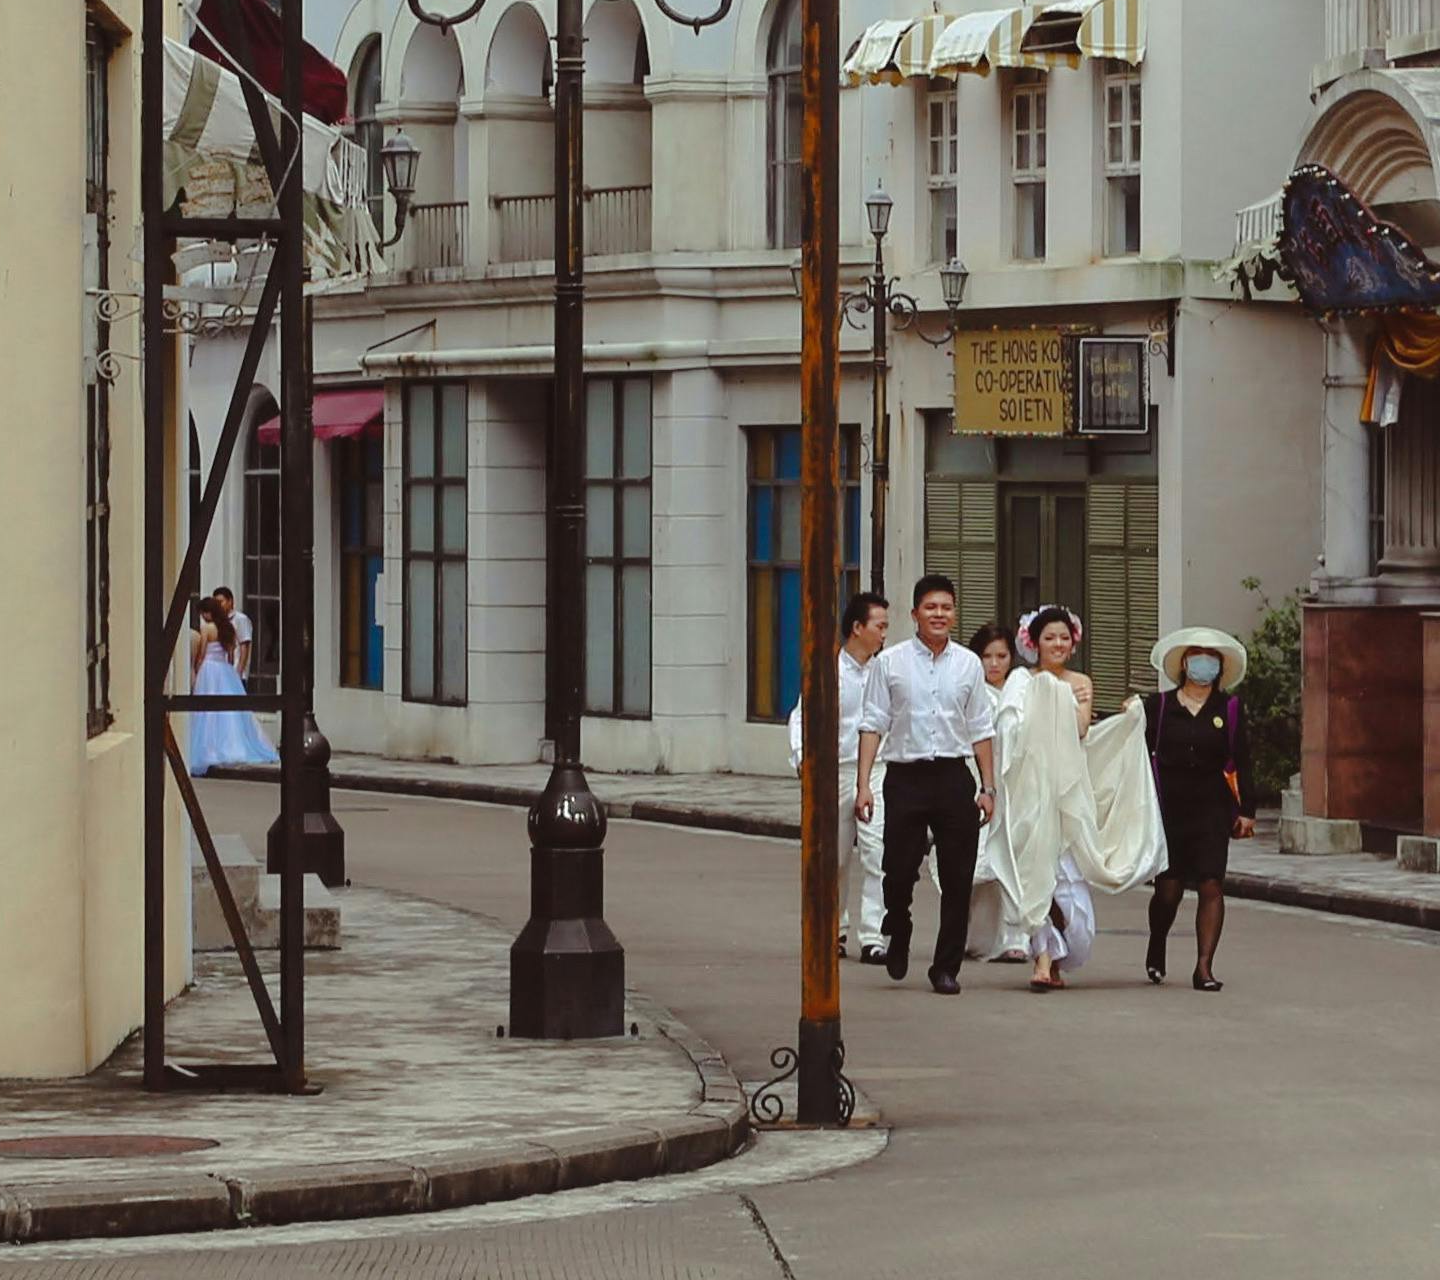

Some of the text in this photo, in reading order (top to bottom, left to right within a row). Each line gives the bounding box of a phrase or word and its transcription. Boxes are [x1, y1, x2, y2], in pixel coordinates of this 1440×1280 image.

[971, 341, 998, 365] THE
[1002, 340, 1038, 364] HONG
[999, 399, 1053, 422] SOIETN
